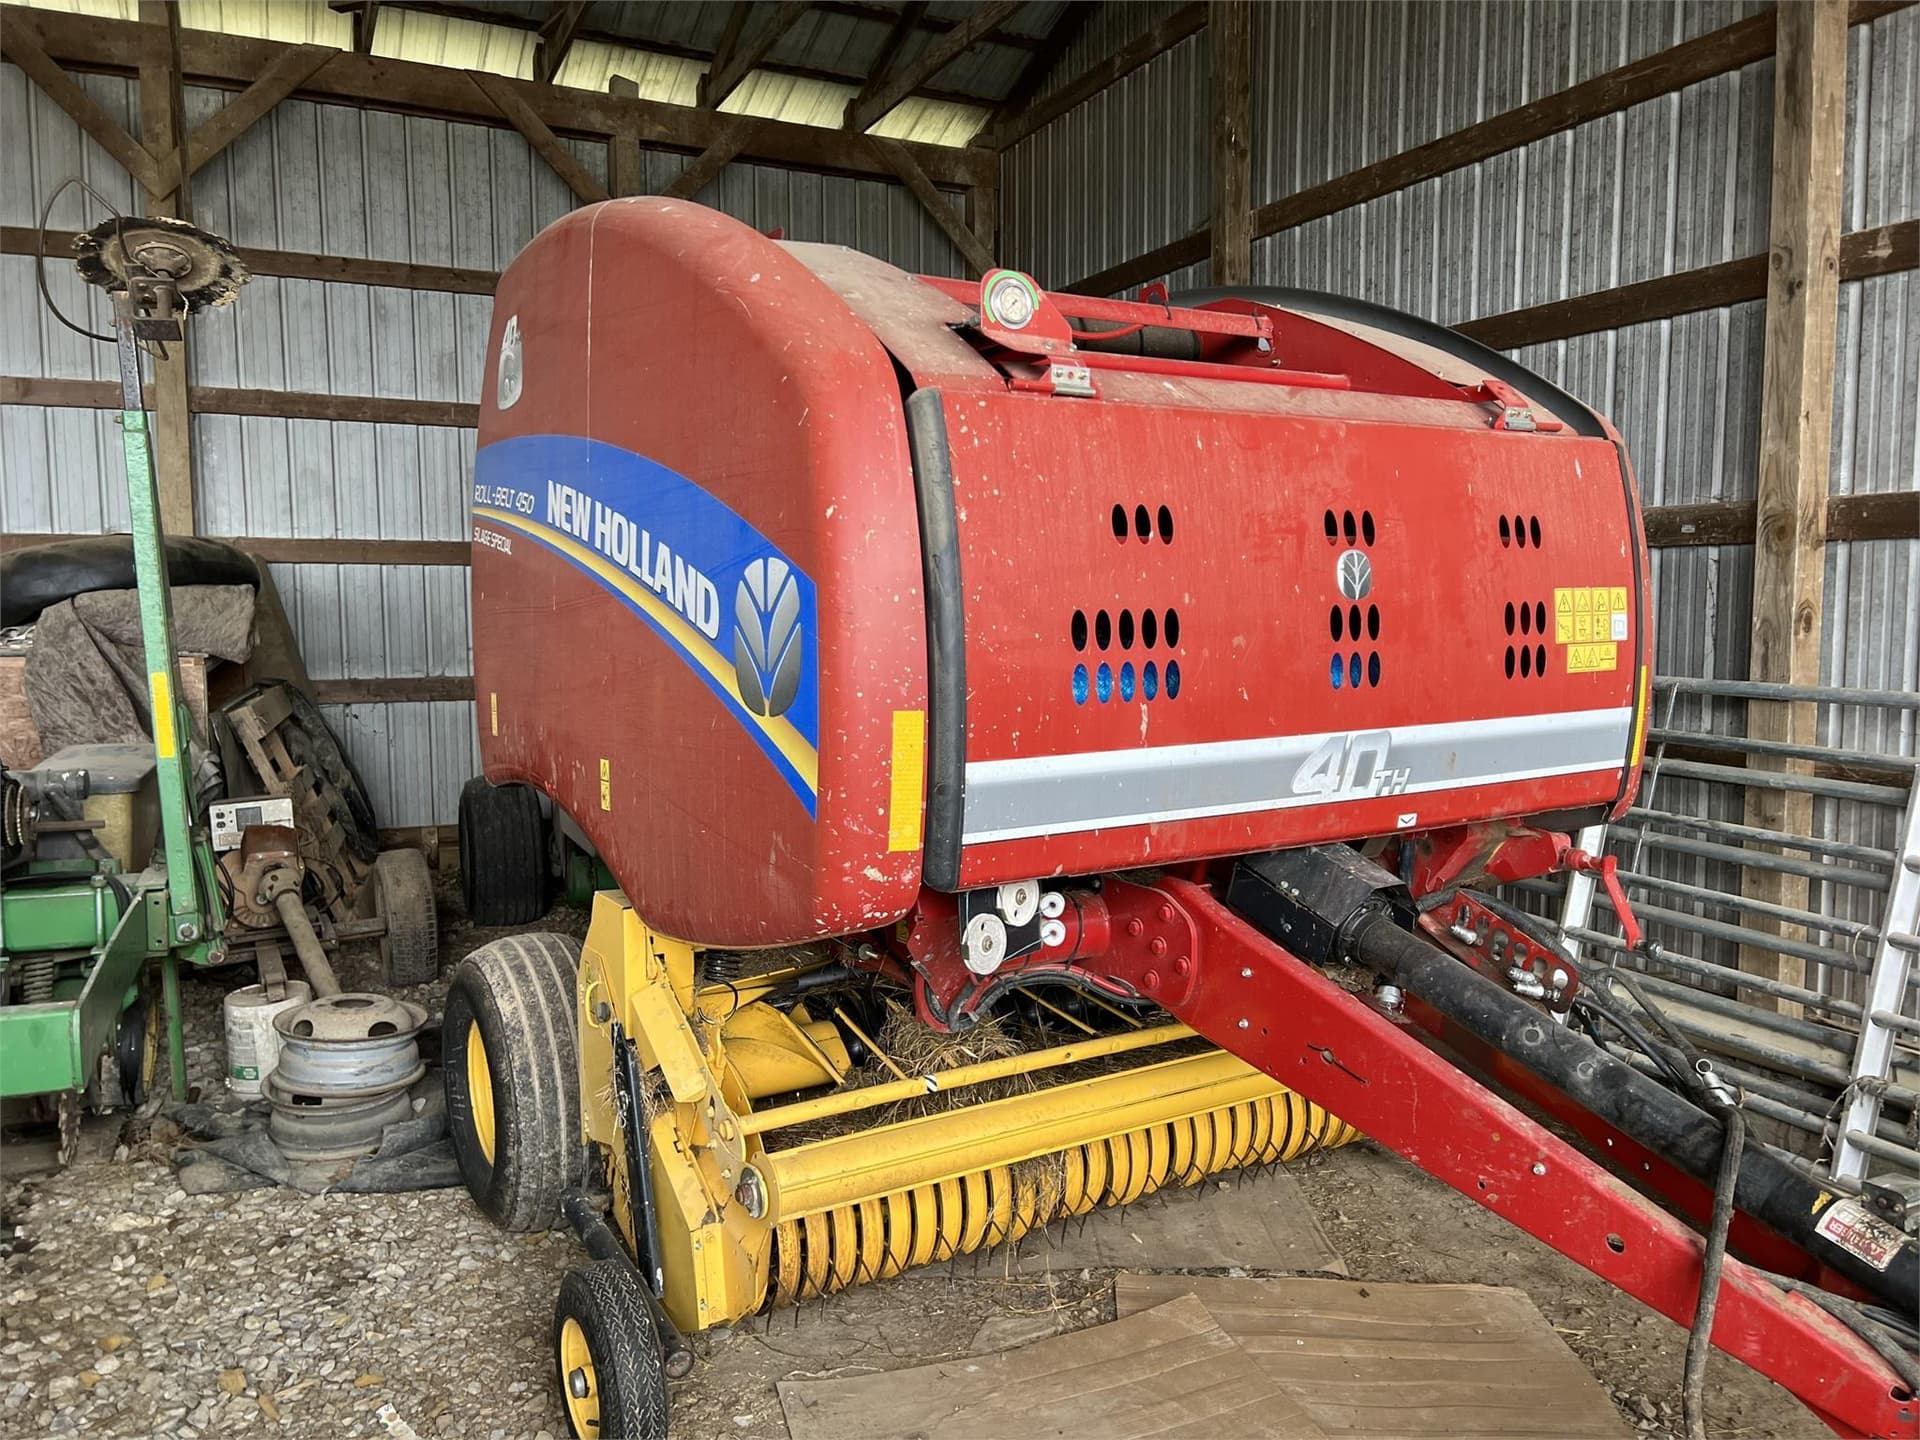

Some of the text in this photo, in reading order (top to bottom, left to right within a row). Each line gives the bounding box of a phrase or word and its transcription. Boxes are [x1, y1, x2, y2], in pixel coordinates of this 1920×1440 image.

[515, 491, 535, 514] 450
[547, 480, 720, 639] NEW HOLLAND
